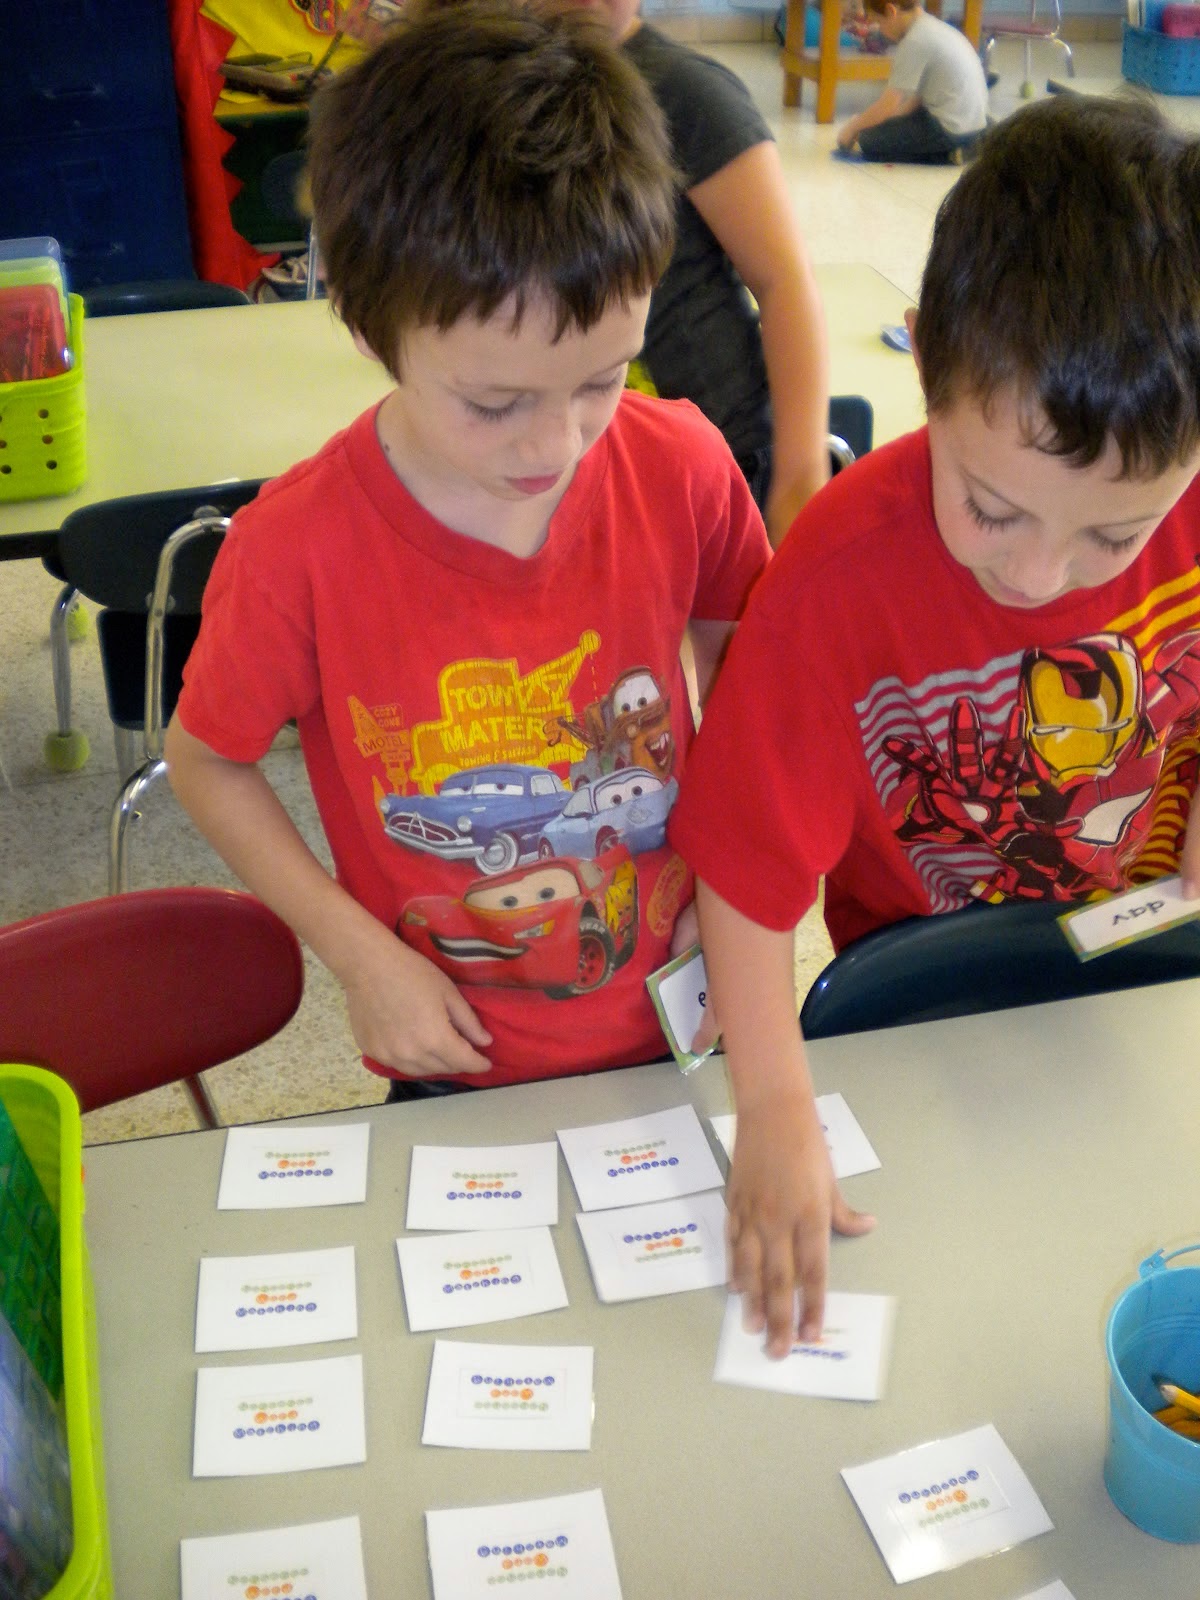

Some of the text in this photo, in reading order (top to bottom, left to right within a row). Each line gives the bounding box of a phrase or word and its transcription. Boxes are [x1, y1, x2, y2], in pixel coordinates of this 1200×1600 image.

[449, 684, 514, 713] TOW
[362, 735, 407, 753] MOTEL
[441, 716, 547, 754] MATER
